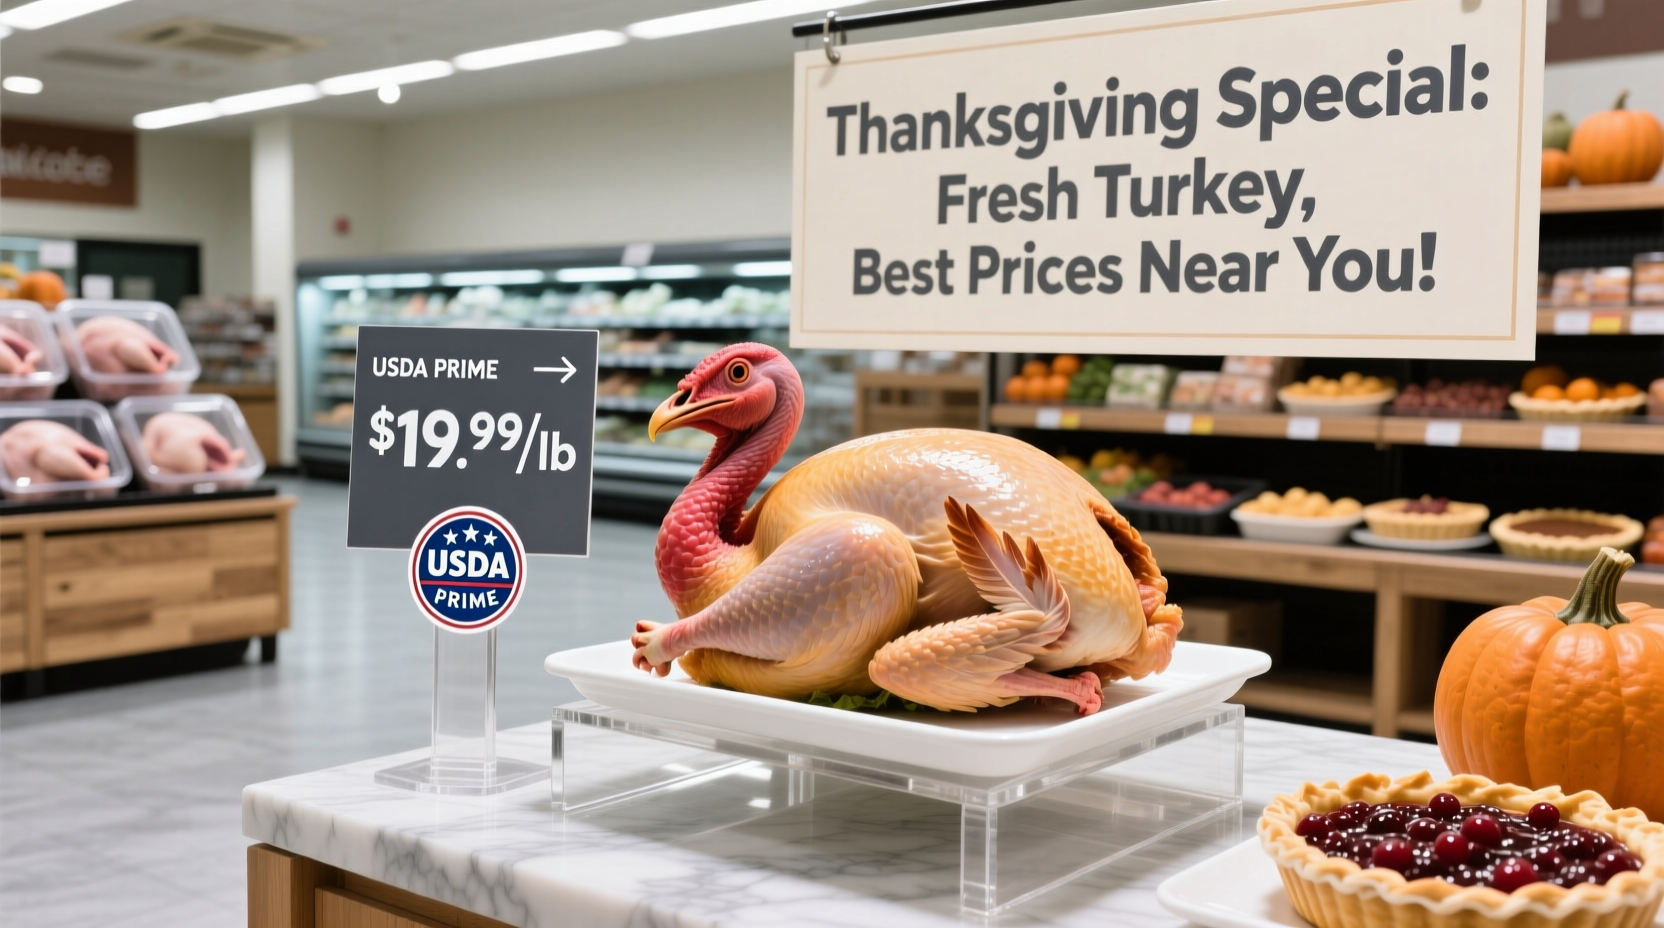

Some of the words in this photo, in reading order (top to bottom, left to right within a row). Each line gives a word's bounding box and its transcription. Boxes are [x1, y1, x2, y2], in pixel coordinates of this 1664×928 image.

[827, 77, 1200, 161] Thanksgiving
[1216, 43, 1491, 142] Special:
[937, 166, 1079, 226] Fresh
[1094, 157, 1317, 230] Turkey,
[852, 248, 955, 296] Best
[968, 241, 1124, 295] Prices
[1140, 239, 1280, 294] Near
[1293, 231, 1438, 293] You!
[372, 356, 428, 378] USDA
[434, 358, 499, 380] PRIME
[369, 404, 577, 475] $19.99/lb
[427, 549, 510, 579] USDA
[434, 588, 500, 610] PRIME
